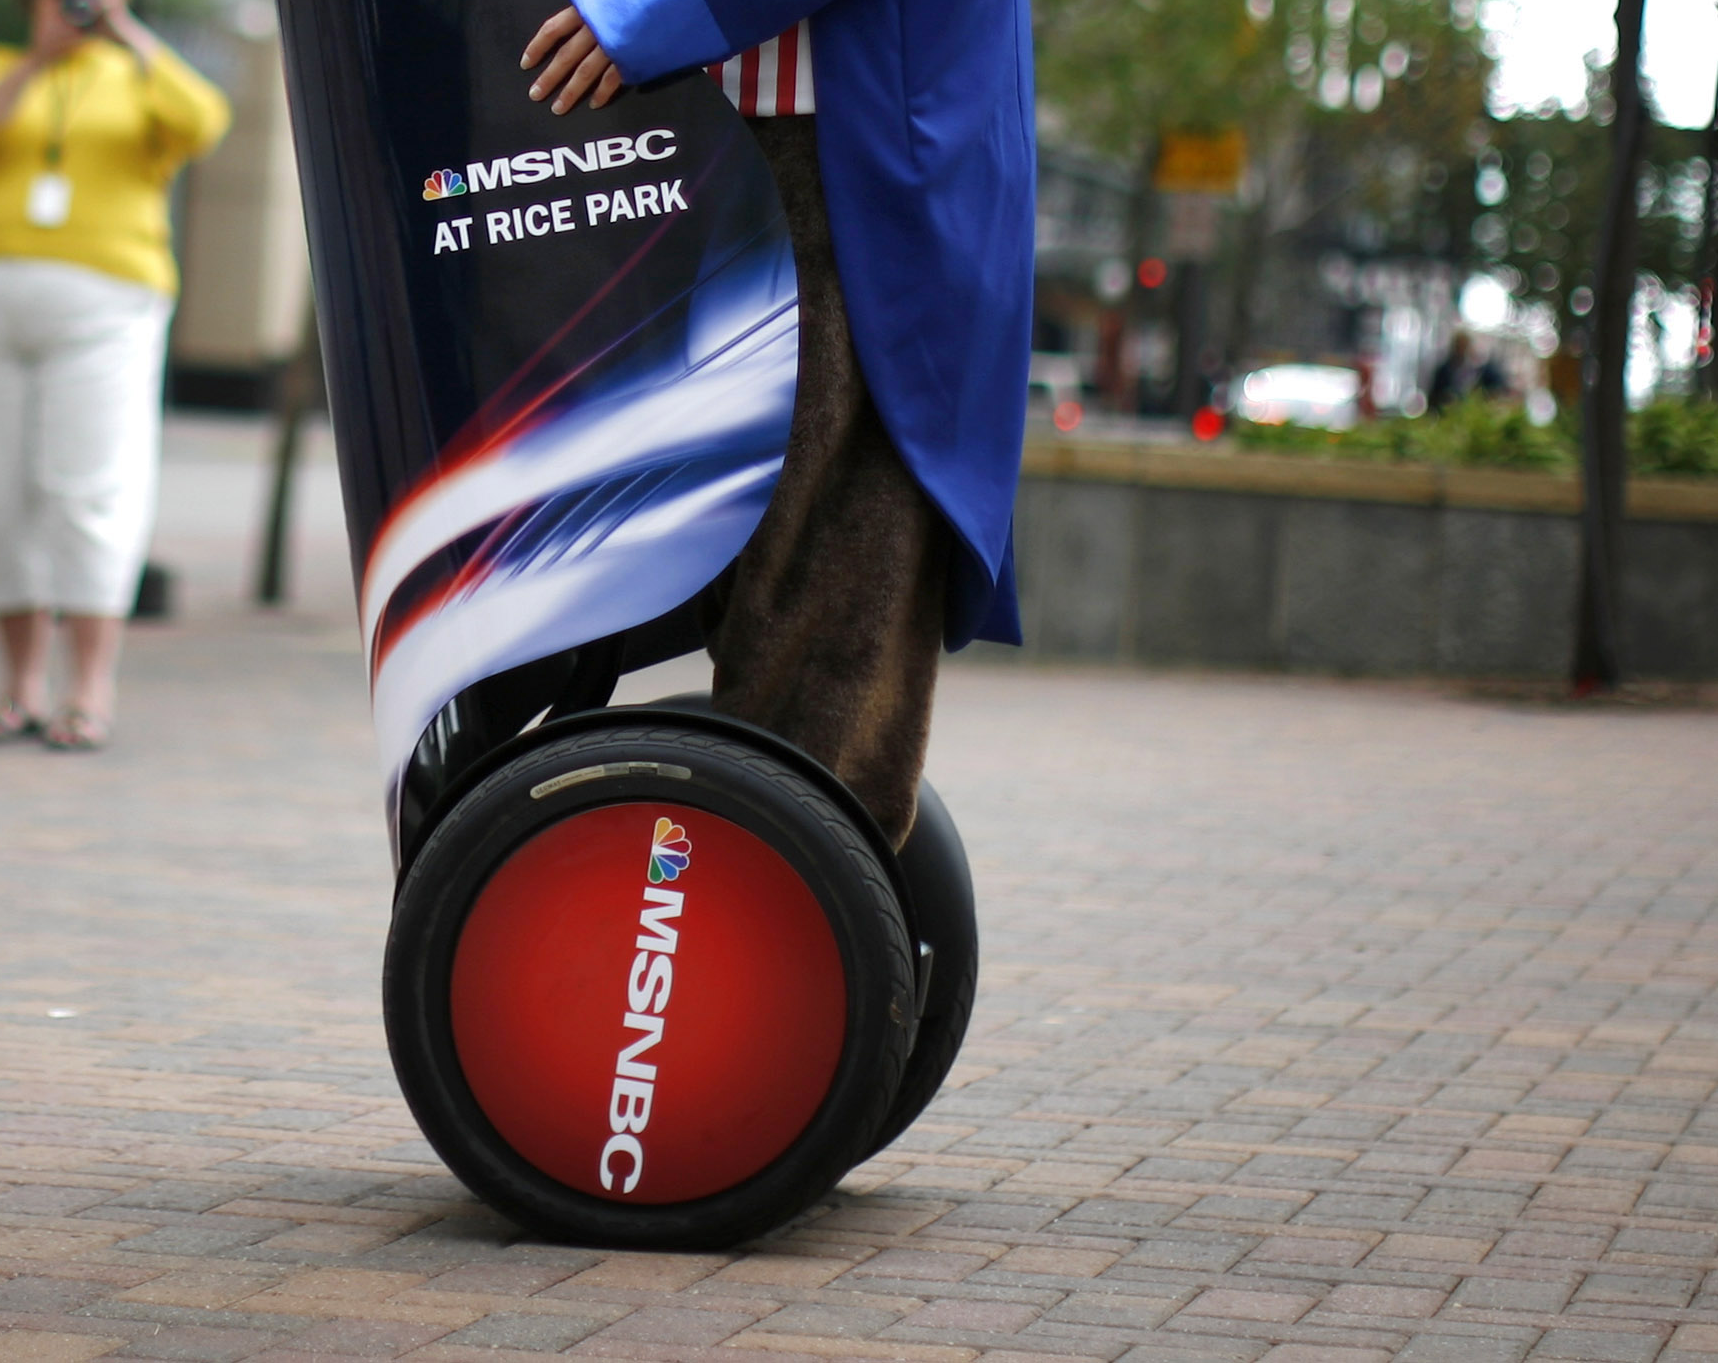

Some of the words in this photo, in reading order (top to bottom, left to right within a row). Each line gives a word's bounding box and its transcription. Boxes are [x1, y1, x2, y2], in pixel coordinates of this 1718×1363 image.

[466, 129, 677, 193] MSNBC
[433, 217, 473, 255] AT
[485, 198, 576, 245] RICE
[585, 178, 689, 227] PARK
[599, 886, 685, 1194] MSNBC
